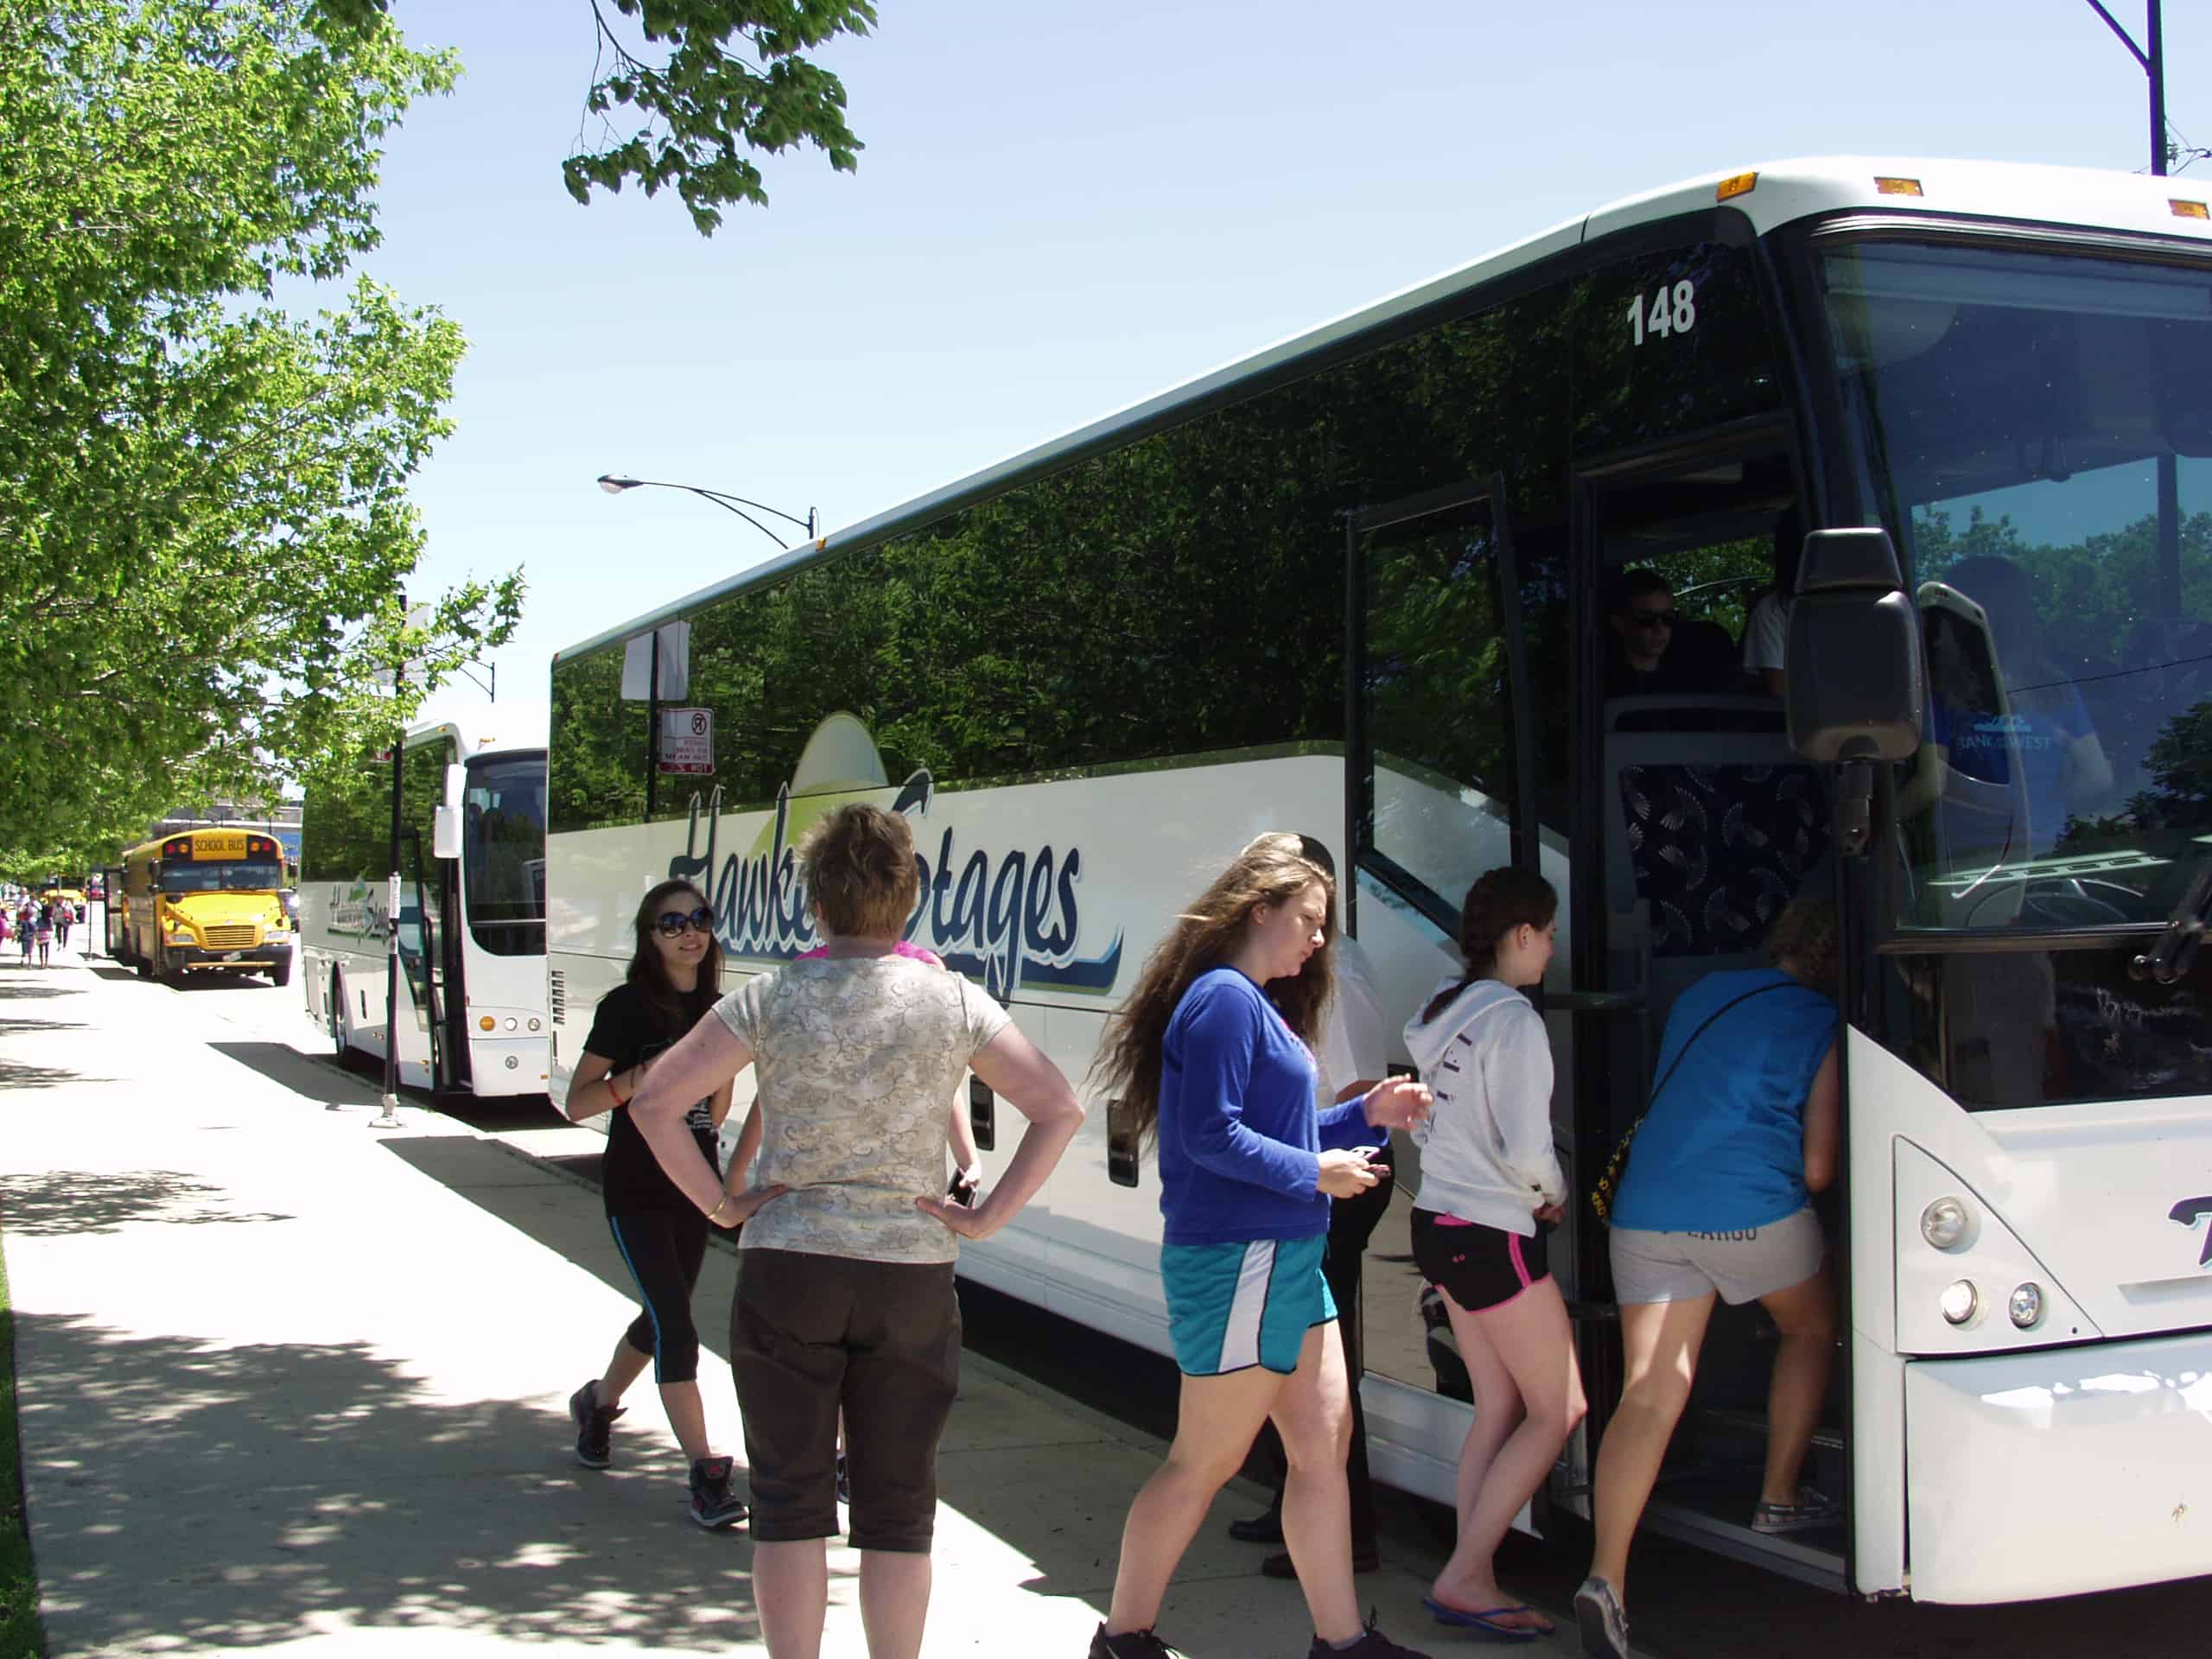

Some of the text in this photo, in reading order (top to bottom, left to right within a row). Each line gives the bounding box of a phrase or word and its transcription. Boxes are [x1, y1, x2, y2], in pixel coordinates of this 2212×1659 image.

[1627, 279, 1696, 346] 148
[194, 838, 245, 851] SCHOOL BUS
[669, 781, 833, 954] Hawke
